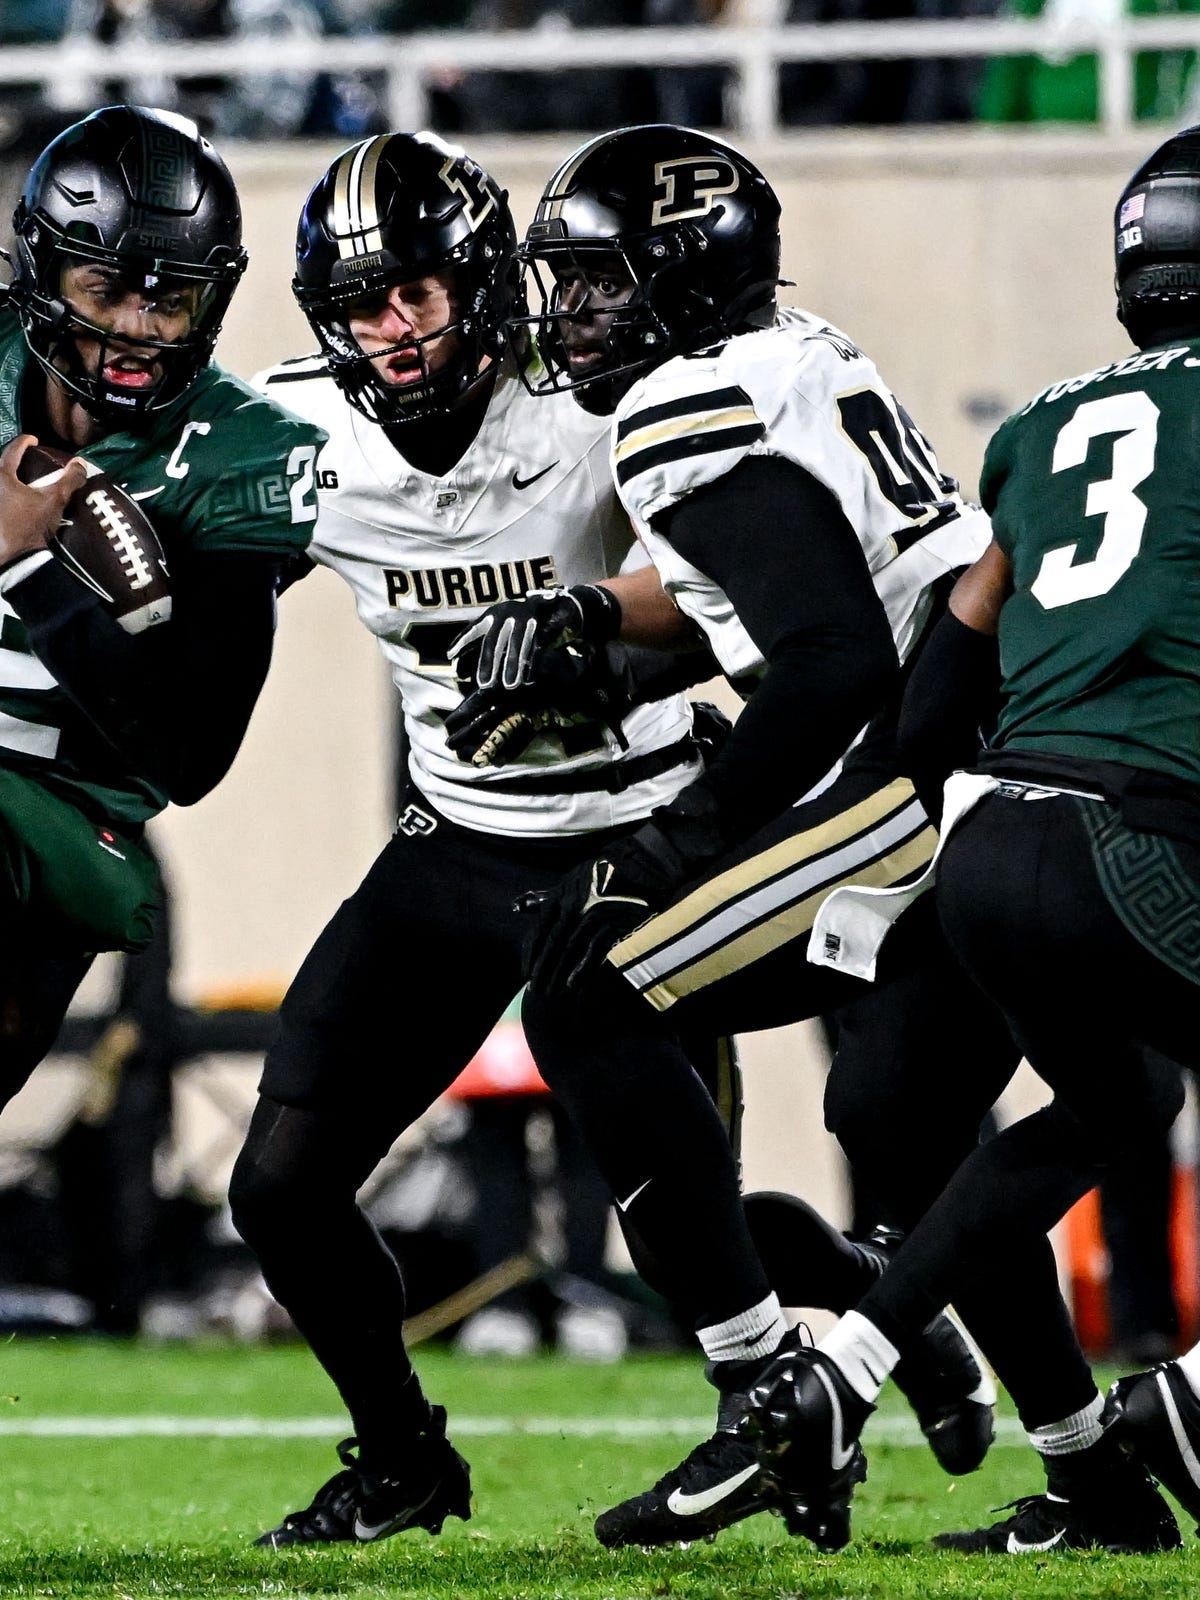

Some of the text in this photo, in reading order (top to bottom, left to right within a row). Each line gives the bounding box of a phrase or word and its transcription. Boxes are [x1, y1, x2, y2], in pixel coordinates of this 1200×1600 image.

[651, 155, 740, 227] P
[166, 421, 212, 480] C
[286, 445, 317, 524] 2
[436, 492, 458, 508] P
[1030, 390, 1161, 611] 3
[398, 803, 438, 837] P
